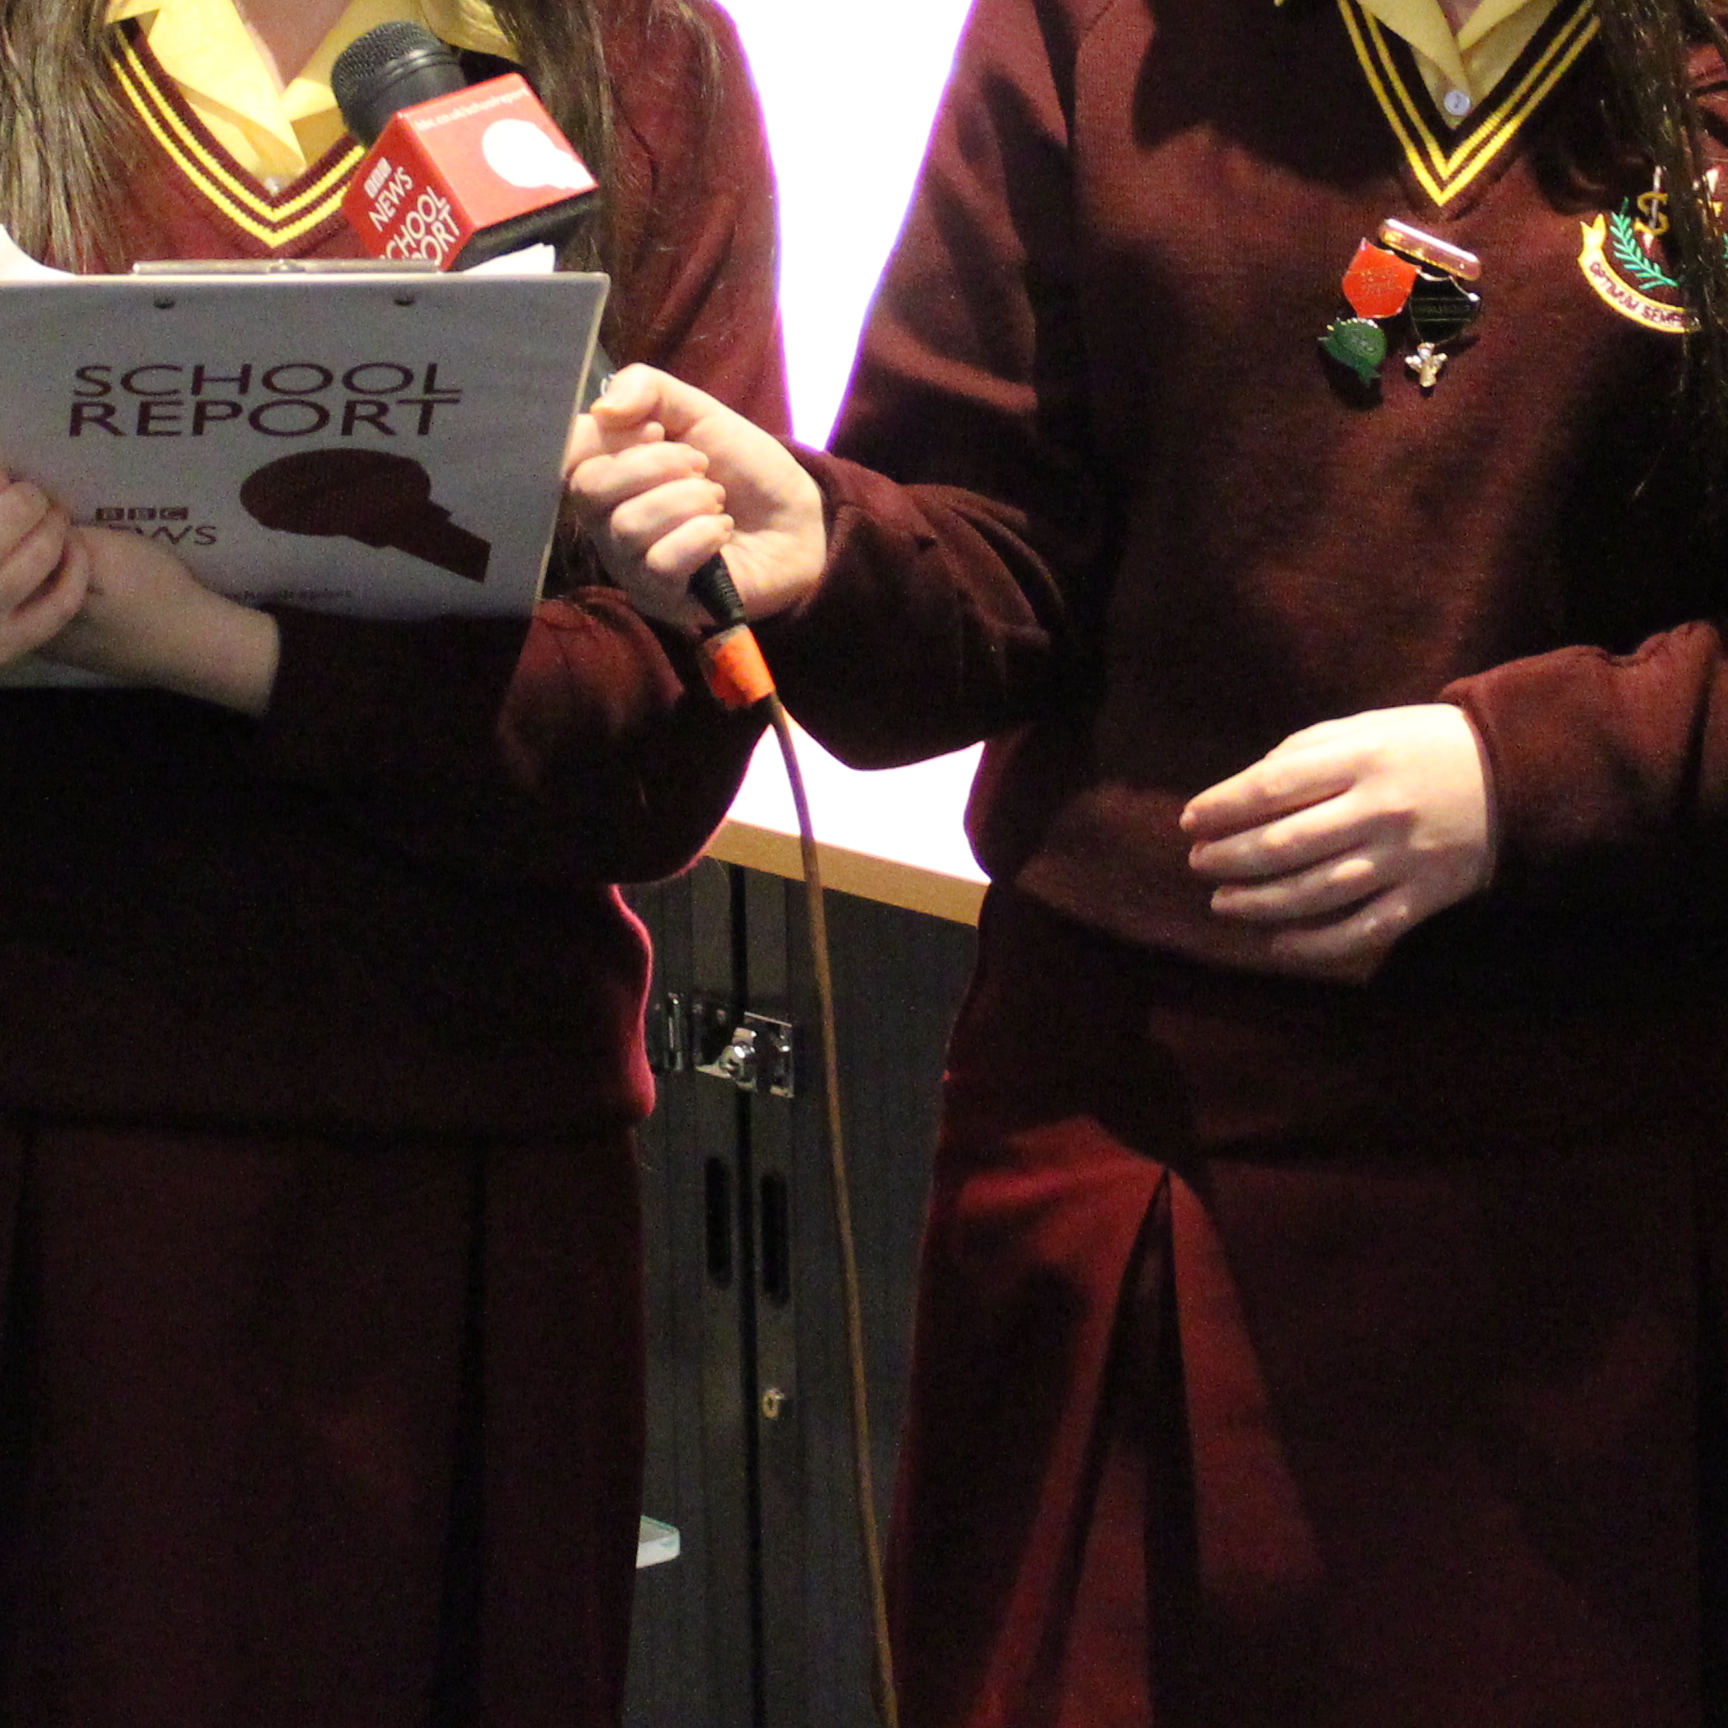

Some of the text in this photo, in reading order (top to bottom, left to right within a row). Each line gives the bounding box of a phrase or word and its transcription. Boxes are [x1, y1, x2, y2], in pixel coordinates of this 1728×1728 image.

[368, 166, 414, 232] NEWS
[379, 186, 447, 259] CHOOL
[73, 362, 463, 398] SCHOOL
[68, 398, 462, 438] REPORT
[95, 506, 189, 522] BBC
